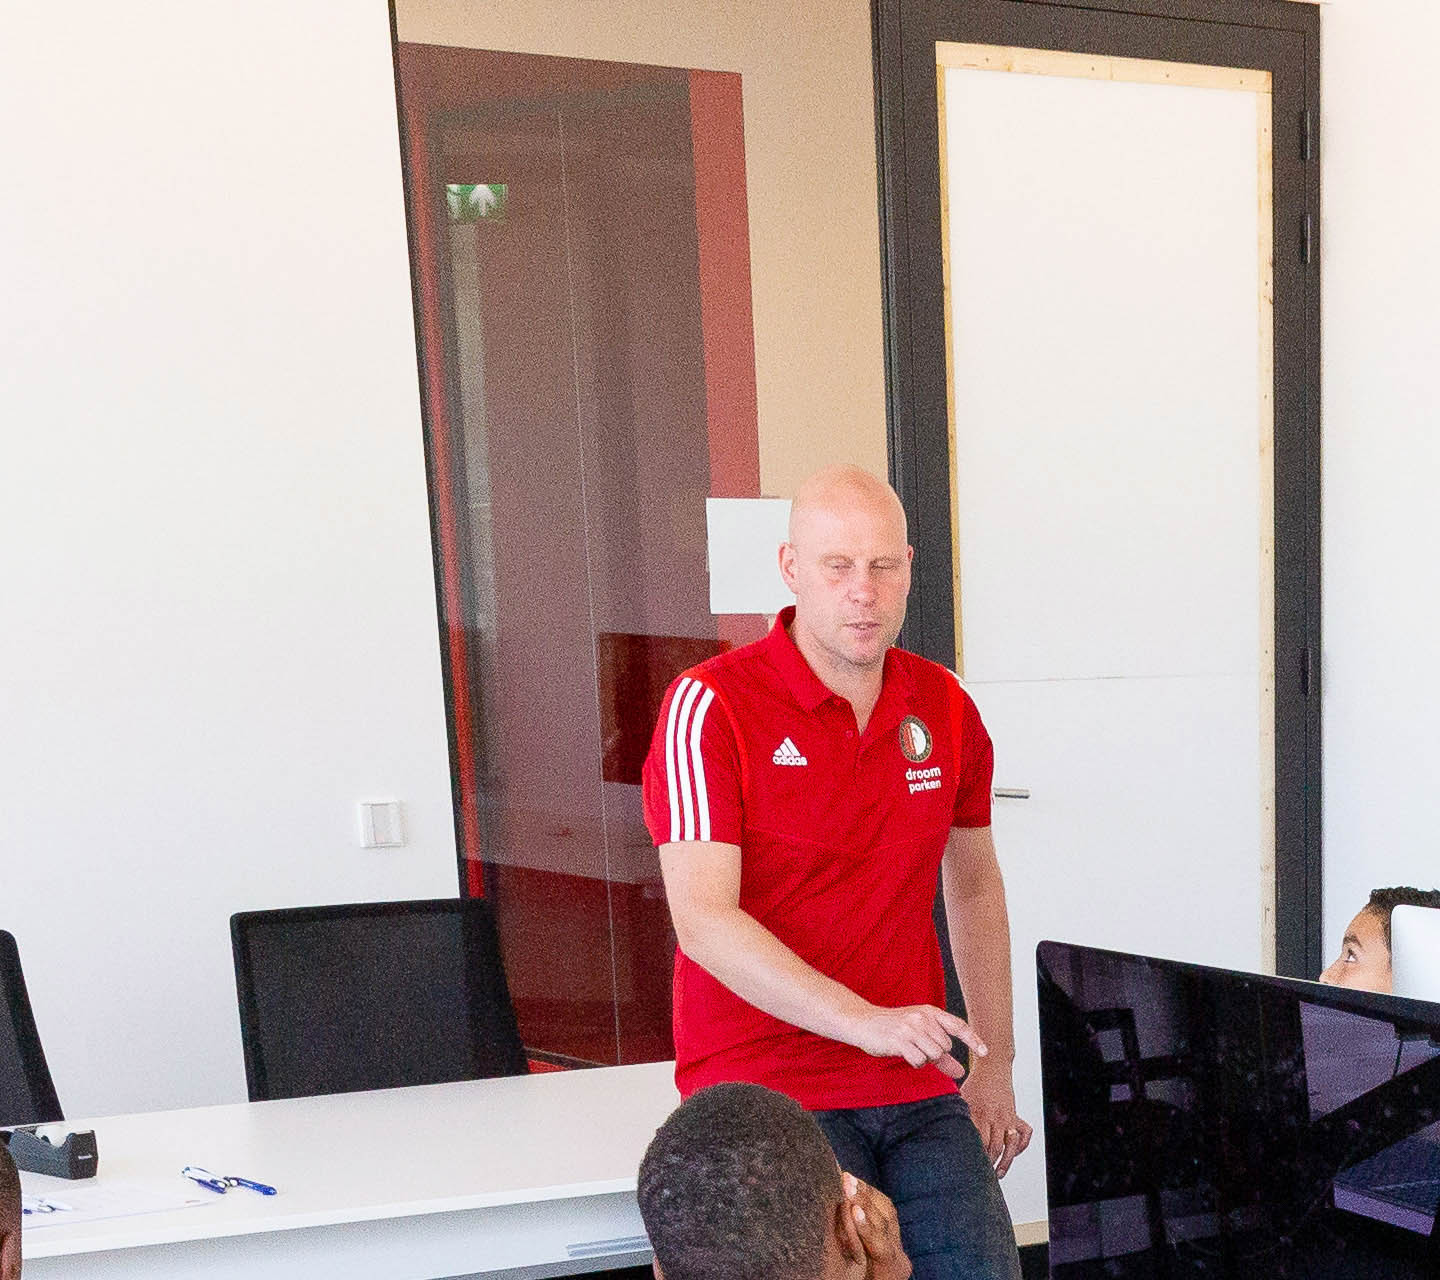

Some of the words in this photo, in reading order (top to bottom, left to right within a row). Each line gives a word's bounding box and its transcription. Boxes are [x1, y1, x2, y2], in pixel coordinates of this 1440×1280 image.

[772, 754, 808, 766] adidas
[905, 766, 942, 781] droom
[908, 779, 942, 795] parken
